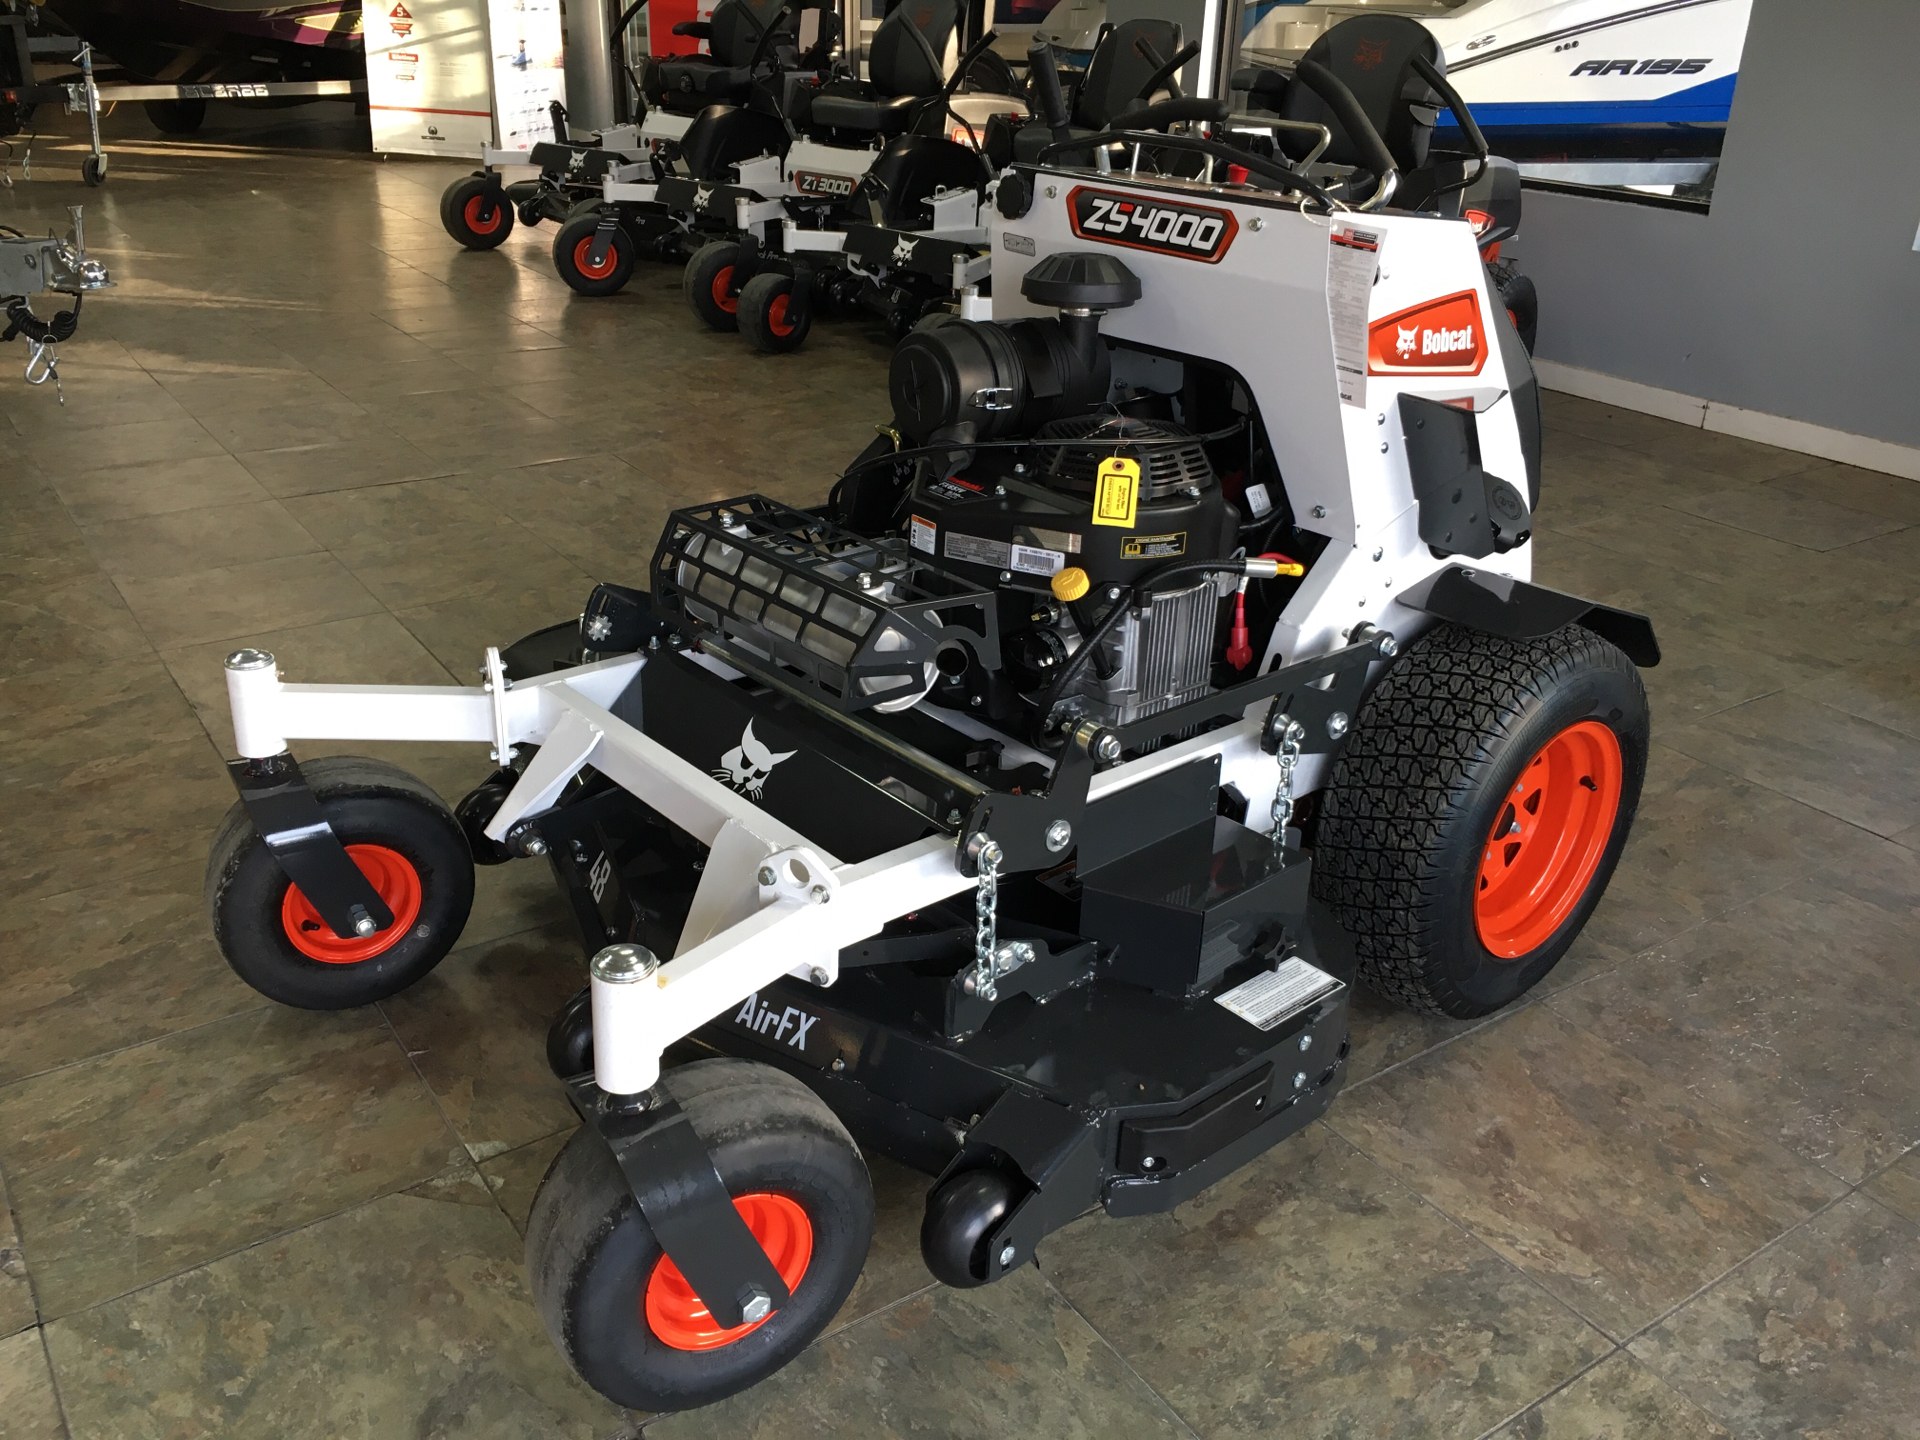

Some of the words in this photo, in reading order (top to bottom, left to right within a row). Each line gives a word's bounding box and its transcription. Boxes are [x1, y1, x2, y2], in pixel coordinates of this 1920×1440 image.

[1569, 58, 1714, 76] AR195
[801, 175, 852, 195] ZT3000
[1082, 197, 1224, 251] ZS4000
[1422, 324, 1474, 356] Bobcat
[589, 850, 612, 904] 48
[734, 992, 818, 1051] AirFX
